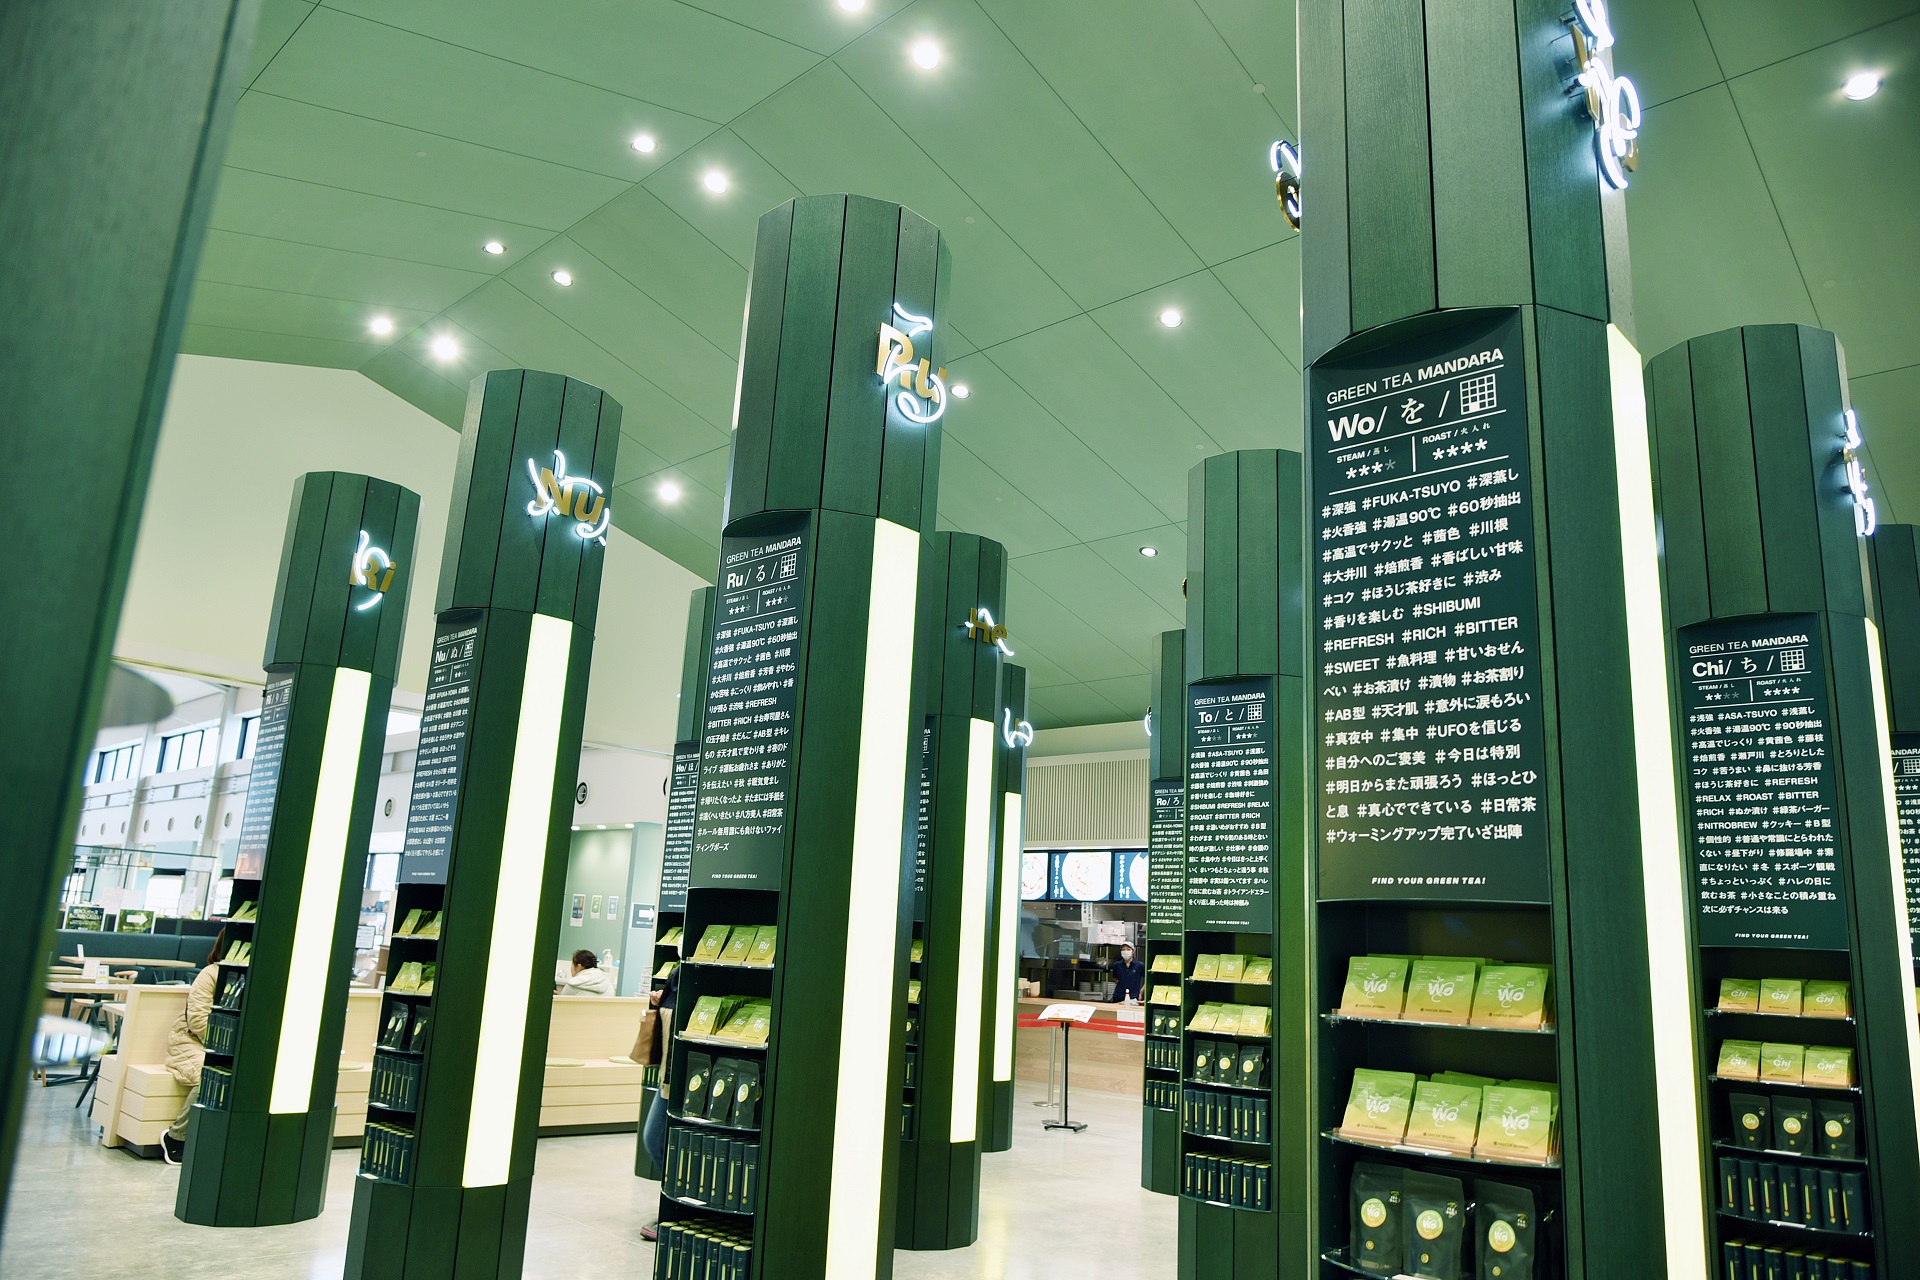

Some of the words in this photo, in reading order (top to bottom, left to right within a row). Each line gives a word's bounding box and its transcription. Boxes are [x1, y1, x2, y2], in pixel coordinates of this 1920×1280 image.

[1326, 380, 1377, 405] GREEN
[1381, 372, 1413, 390] TEA
[1417, 347, 1504, 382] MANDARA
[1400, 397, 1425, 425] を
[1422, 430, 1452, 445] ROAST
[1336, 450, 1366, 464] STEAM
[1321, 500, 1357, 519] #深強
[1361, 479, 1461, 511] #FUKA-TSUYO
[1466, 468, 1519, 490] #深蒸し
[1321, 520, 1367, 541] #火香強
[1447, 491, 1521, 518] #60秒抽出
[1322, 534, 1413, 563] #高温でサクッと
[1421, 526, 1461, 546] #茜色
[1468, 517, 1509, 538] #川根
[726, 550, 749, 565] GREEN
[750, 546, 764, 558] TEA
[765, 536, 802, 554] MANDARA
[1322, 565, 1367, 586] #大井川
[1373, 555, 1424, 577] #焙煎香
[1430, 539, 1524, 568] #香ばしい甘味
[1322, 591, 1355, 608] #コク
[1361, 575, 1457, 602] #ほうじ茶好きに
[1462, 568, 1502, 587] #渋み
[1323, 607, 1405, 631] #香りを楽しむ
[1412, 596, 1481, 618] #SHIBUMI
[732, 620, 776, 638] #FUKA-TSUYO
[1323, 632, 1395, 654] #REFRESH
[1401, 625, 1447, 644] #RICH
[1454, 616, 1519, 637] #BITTER
[1689, 643, 1725, 654] GREEN
[1727, 640, 1749, 650] TEA
[1751, 634, 1809, 648] MANDARA
[1323, 657, 1381, 677] #SWEET
[1385, 650, 1438, 670] #魚料理
[1444, 640, 1525, 663] #甘いおせん
[1740, 656, 1758, 674] ち
[1323, 685, 1348, 697] べい
[1352, 677, 1412, 697] #お茶漬け
[1417, 672, 1457, 691] #漬物
[1461, 665, 1524, 686] #お茶割り
[744, 696, 778, 710] #REFRESH
[1193, 697, 1216, 706] GREEN
[1217, 695, 1231, 703] TEA
[1231, 692, 1266, 702] MANDARA
[1324, 705, 1366, 724] #AB型
[1371, 701, 1419, 720] #天才肌
[1424, 692, 1531, 715] #意外に涙もろい
[707, 718, 732, 730] #BITTER
[732, 715, 753, 727] #RICH
[1717, 709, 1778, 721] #ASA-TSUYO
[1324, 729, 1374, 747] #真夜中
[1379, 725, 1419, 743] #集中
[1425, 718, 1522, 740] #UFOを信じる
[1207, 749, 1244, 758] #ASA-TSUYO
[1325, 750, 1426, 771] #自分へのご褒美
[1434, 743, 1521, 764] #今日は特別
[1325, 773, 1462, 795] #明日からまた頑張ろう
[1470, 770, 1538, 788] #ほっとひ
[1764, 776, 1818, 787] #REFRESH
[1246, 801, 1270, 809] #RELAX
[1695, 794, 1732, 803] #RELAX
[1735, 792, 1774, 802] #ROAST
[1777, 790, 1820, 801] #BITTER
[1189, 813, 1214, 821] #ROAST
[1214, 812, 1240, 820] #BITTER
[1241, 812, 1261, 820] #RICH
[1325, 803, 1350, 819] と息
[1356, 799, 1472, 818] #真心でできている
[1480, 796, 1537, 814] #日常茶
[1696, 808, 1725, 817] #RICH
[1325, 823, 1523, 844] #ウォーミングアップ完了いざ出陣
[1697, 821, 1758, 831] #NITROBREW
[1371, 877, 1395, 885] FIND
[1397, 876, 1424, 885] YOUR
[1425, 876, 1458, 885] GREEN
[1456, 876, 1486, 885] TEA!
[1363, 976, 1388, 996] Wo
[1428, 979, 1454, 1000] Wo
[1498, 985, 1525, 1005] Wo
[1366, 1096, 1391, 1116] Wo
[1432, 1104, 1458, 1124] Wo
[1502, 1109, 1529, 1132] Wo
